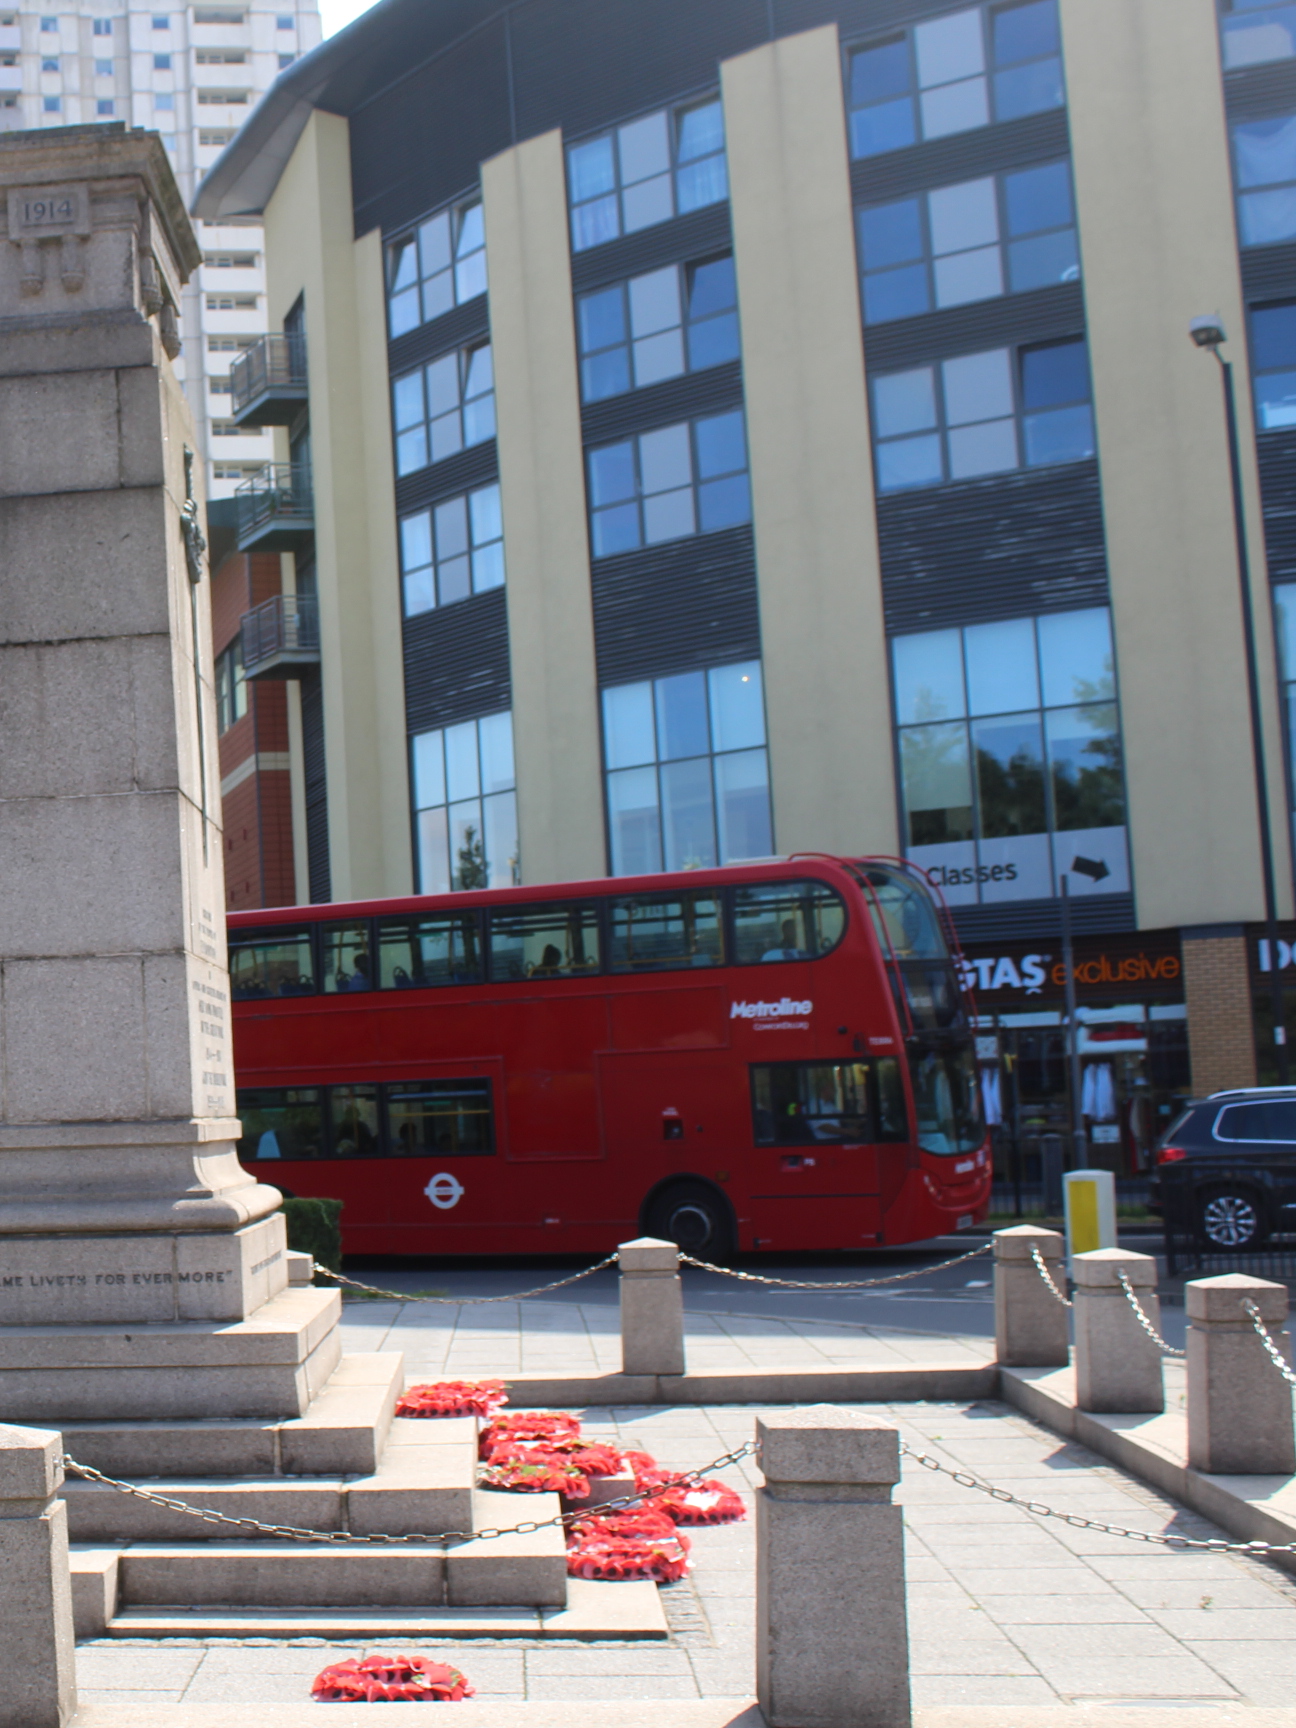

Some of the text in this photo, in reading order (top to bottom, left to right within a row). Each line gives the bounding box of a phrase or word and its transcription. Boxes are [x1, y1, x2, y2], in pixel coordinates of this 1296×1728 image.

[24, 200, 73, 220] 1914
[925, 863, 1018, 887] Classes
[1051, 954, 1180, 986] exclusive
[729, 997, 813, 1019] Metroline
[30, 1275, 87, 1286] LIVETH
[95, 1274, 125, 1285] FOR
[133, 1272, 172, 1284] EVER
